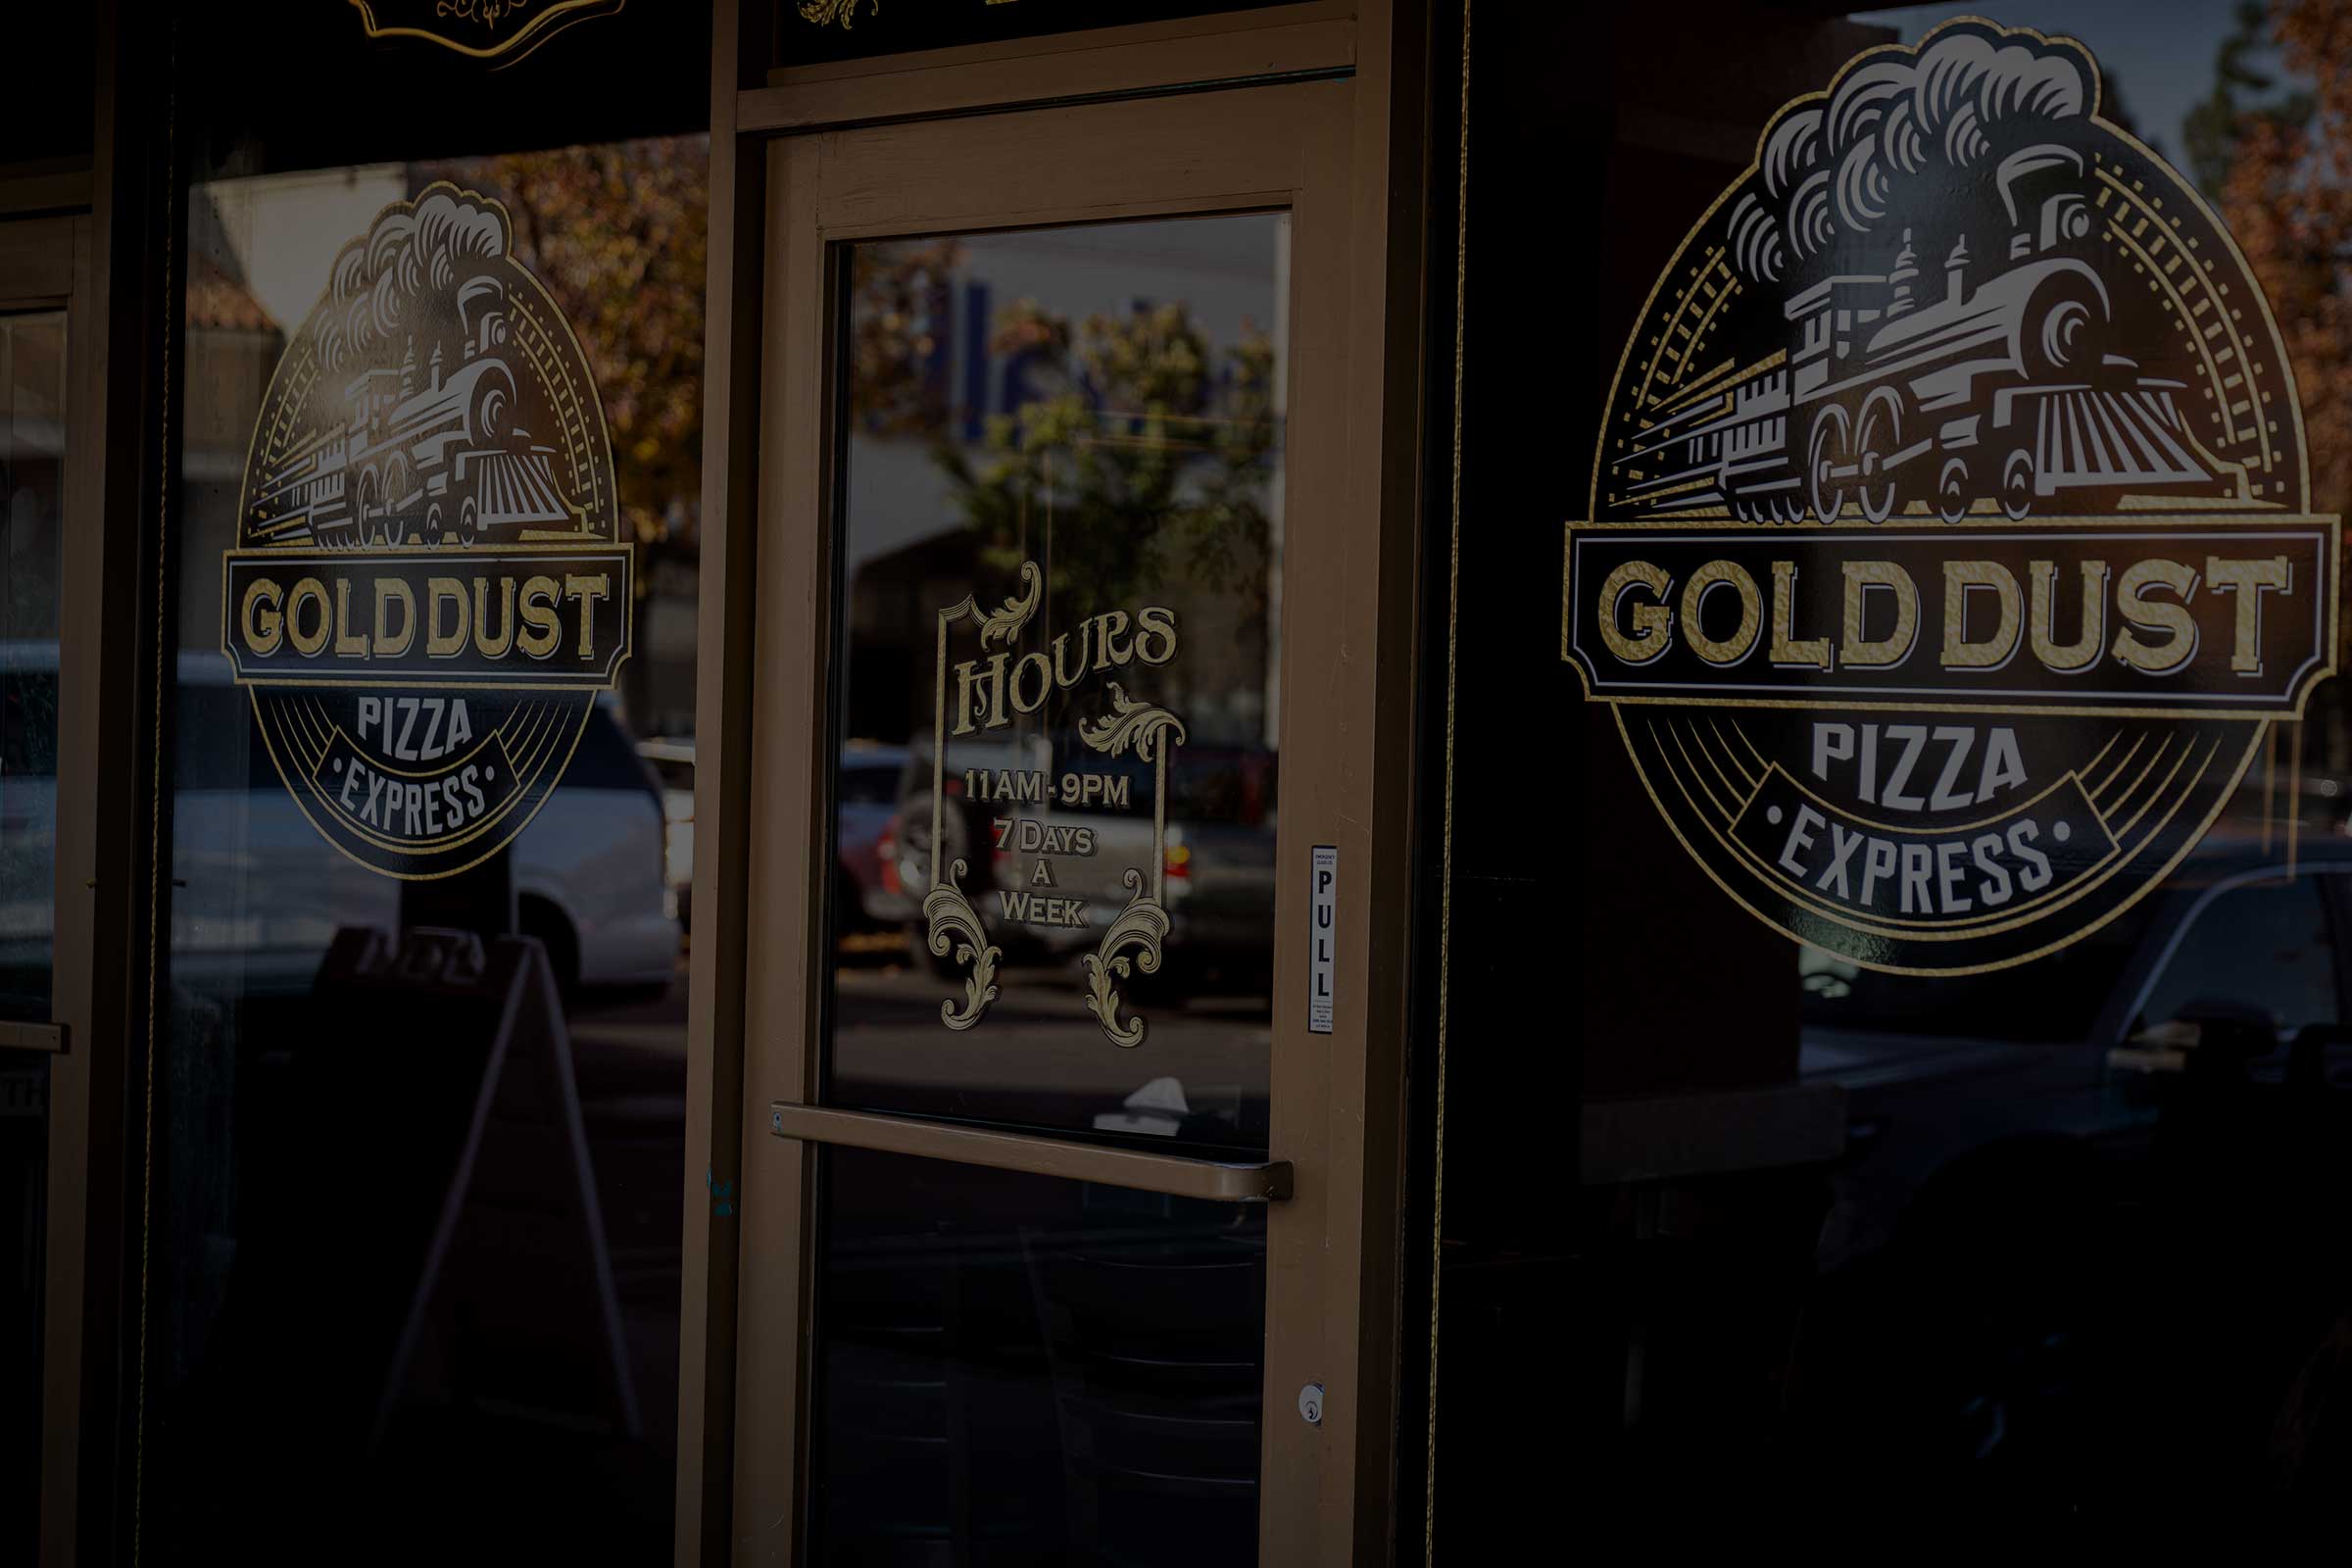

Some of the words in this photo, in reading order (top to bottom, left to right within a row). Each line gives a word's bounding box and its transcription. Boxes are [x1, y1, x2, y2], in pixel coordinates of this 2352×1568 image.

[241, 576, 417, 661] GOLD
[426, 573, 611, 662] DUST
[1597, 560, 1922, 674] GOLD
[1939, 556, 2294, 676] DUST
[951, 607, 1178, 736] HOURS
[358, 696, 473, 761] PIZZA
[1812, 721, 2029, 812] PIZZA
[339, 756, 486, 836] EXPRESS
[991, 816, 1014, 851] 7
[1019, 819, 1097, 857] DAYS
[1030, 858, 1057, 887] A
[1778, 803, 2055, 915] EXPRESS
[999, 891, 1089, 928] WEEK
[1317, 870, 1333, 997] PULL
